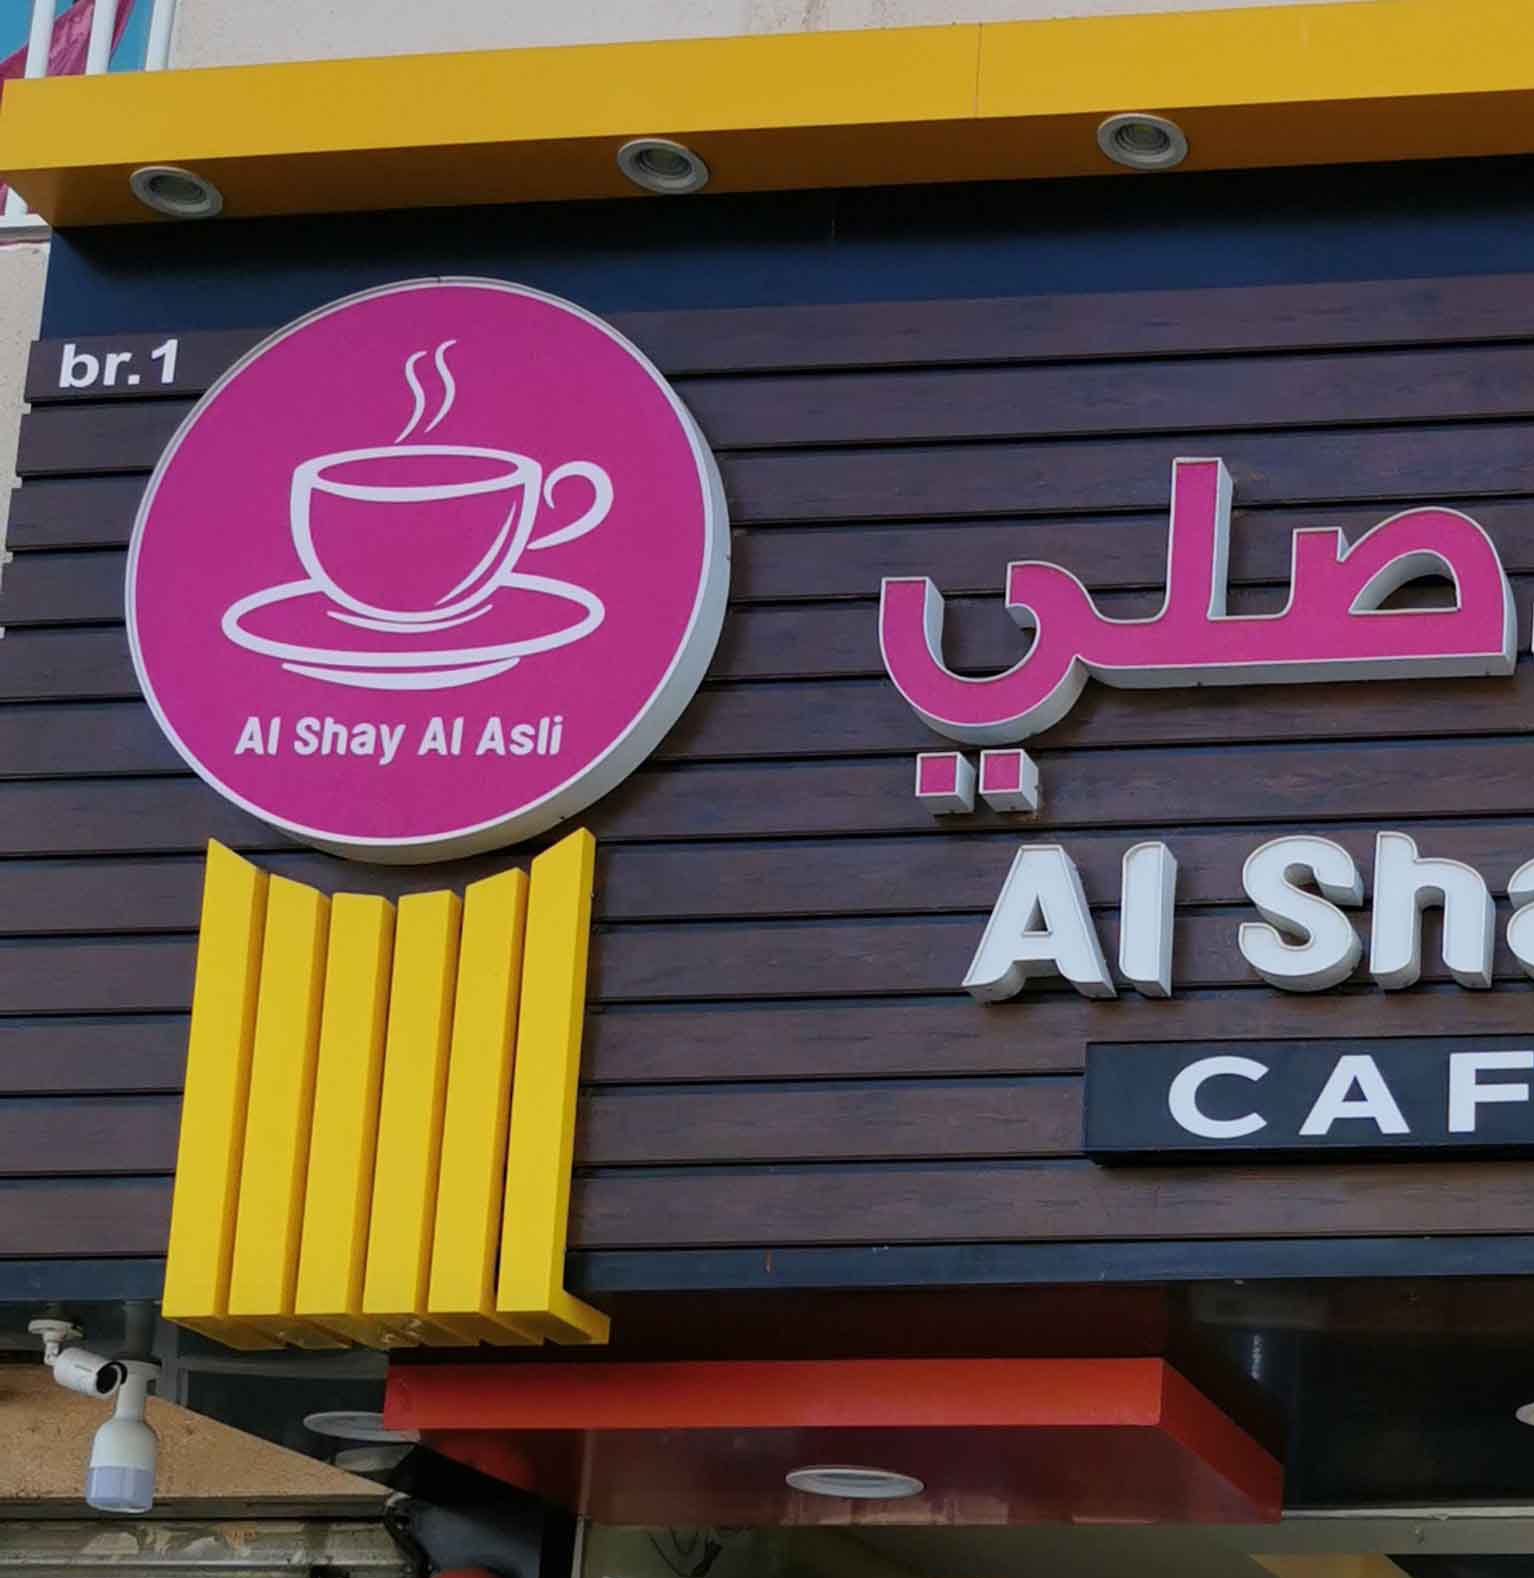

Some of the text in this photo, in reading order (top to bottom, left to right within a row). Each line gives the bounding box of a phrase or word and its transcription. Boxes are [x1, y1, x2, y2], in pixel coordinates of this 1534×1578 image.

[59, 339, 180, 388] br.1
[234, 715, 564, 766] Al Shay Al Asli
[961, 840, 1178, 1001] Al
